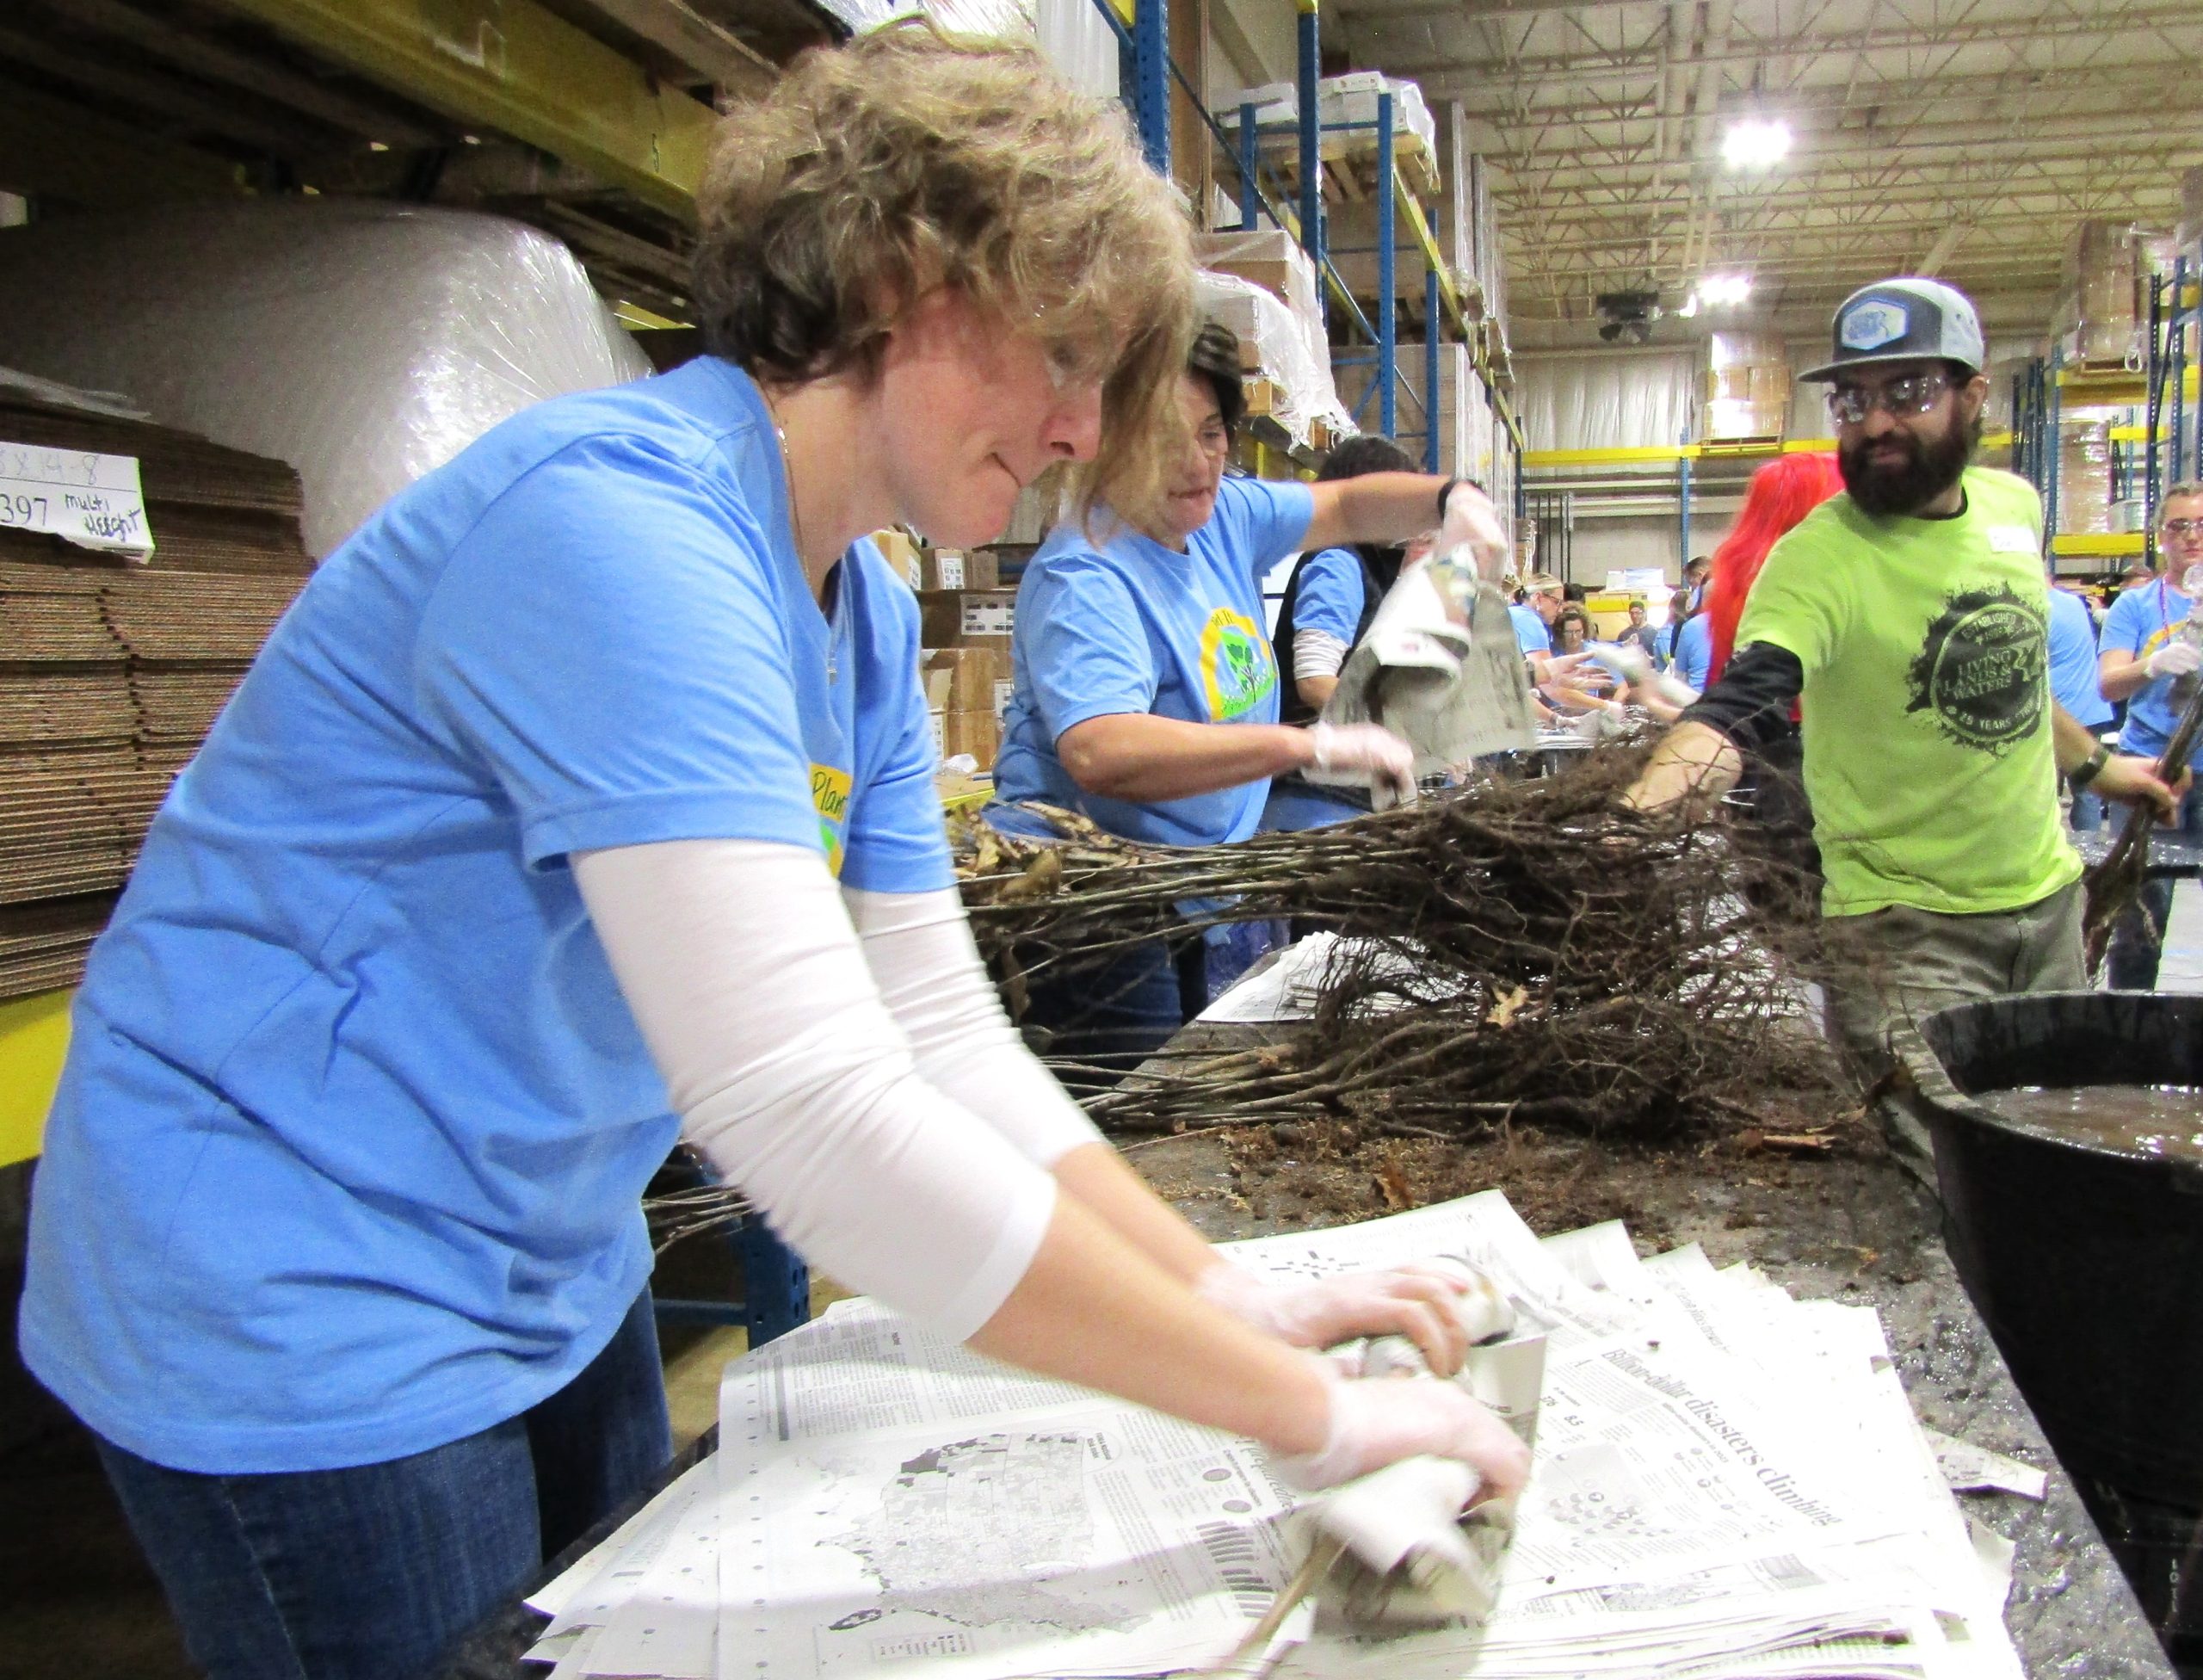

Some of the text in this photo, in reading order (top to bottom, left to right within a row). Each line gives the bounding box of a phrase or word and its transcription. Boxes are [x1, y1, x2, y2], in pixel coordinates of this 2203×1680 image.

[1979, 717, 2013, 732] YEARS
[1684, 1400, 1764, 1466] disasters
[1756, 1468, 1842, 1526] climbing
